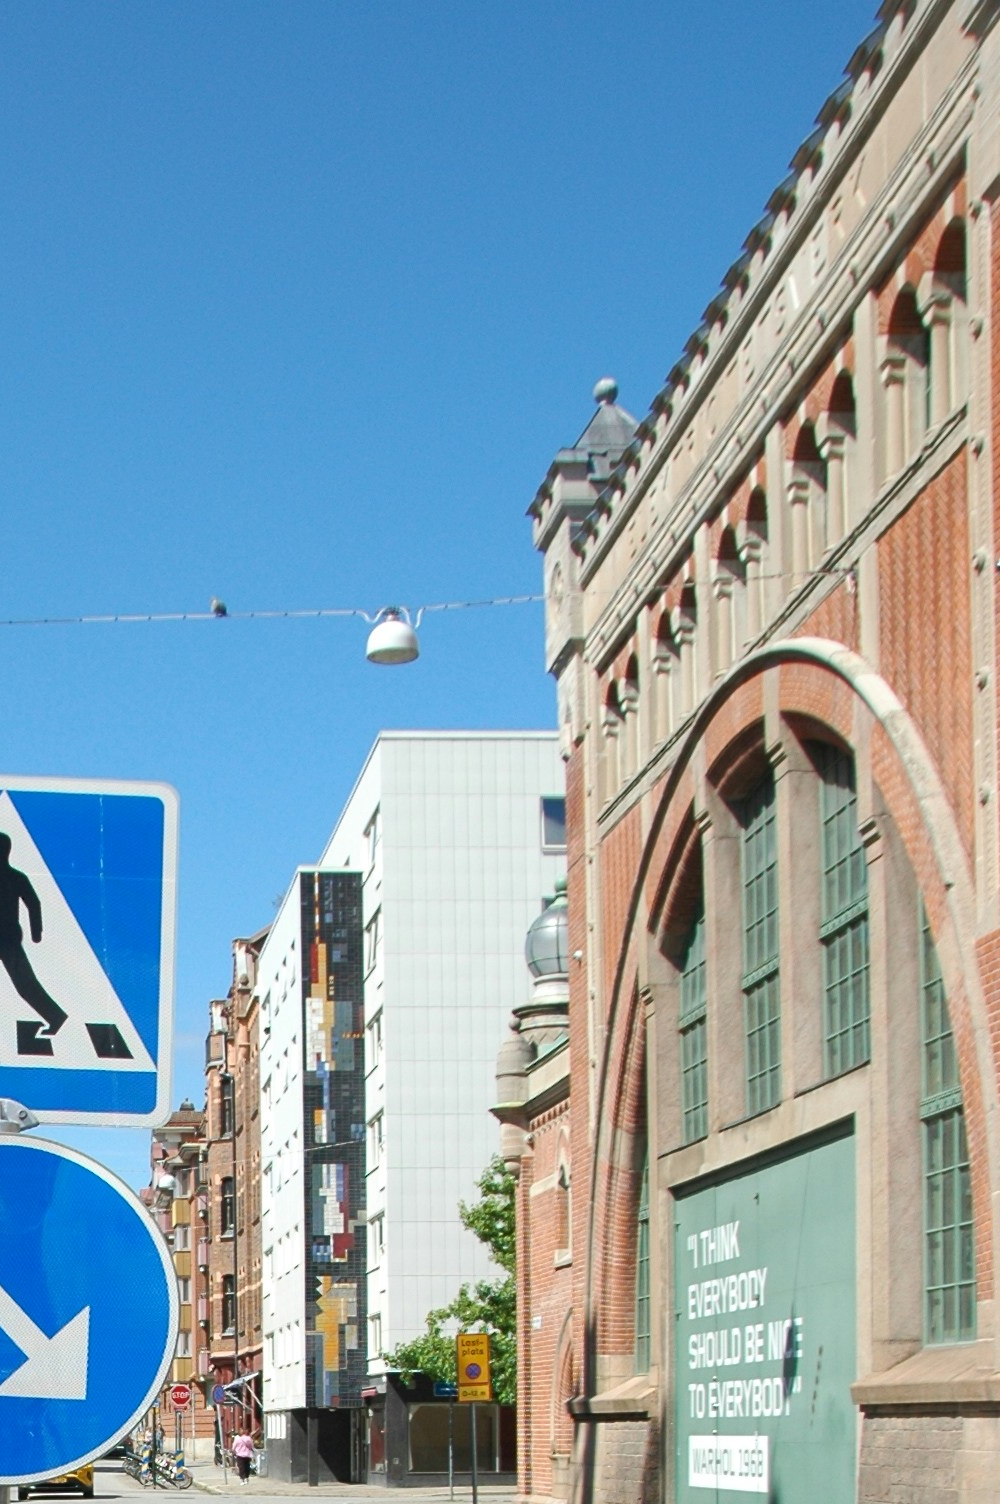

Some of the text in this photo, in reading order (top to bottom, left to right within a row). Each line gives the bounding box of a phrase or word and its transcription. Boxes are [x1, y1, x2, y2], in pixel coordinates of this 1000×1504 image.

[700, 1220, 740, 1266] THINK
[688, 1267, 768, 1320] EVERYBODY
[461, 1348, 484, 1357] plats
[688, 1317, 803, 1370] SHOULD BE NICE
[172, 1391, 190, 1399] STOP
[688, 1376, 802, 1419] TO EVERYBODY"
[692, 1448, 763, 1478] WARHOL 1968
